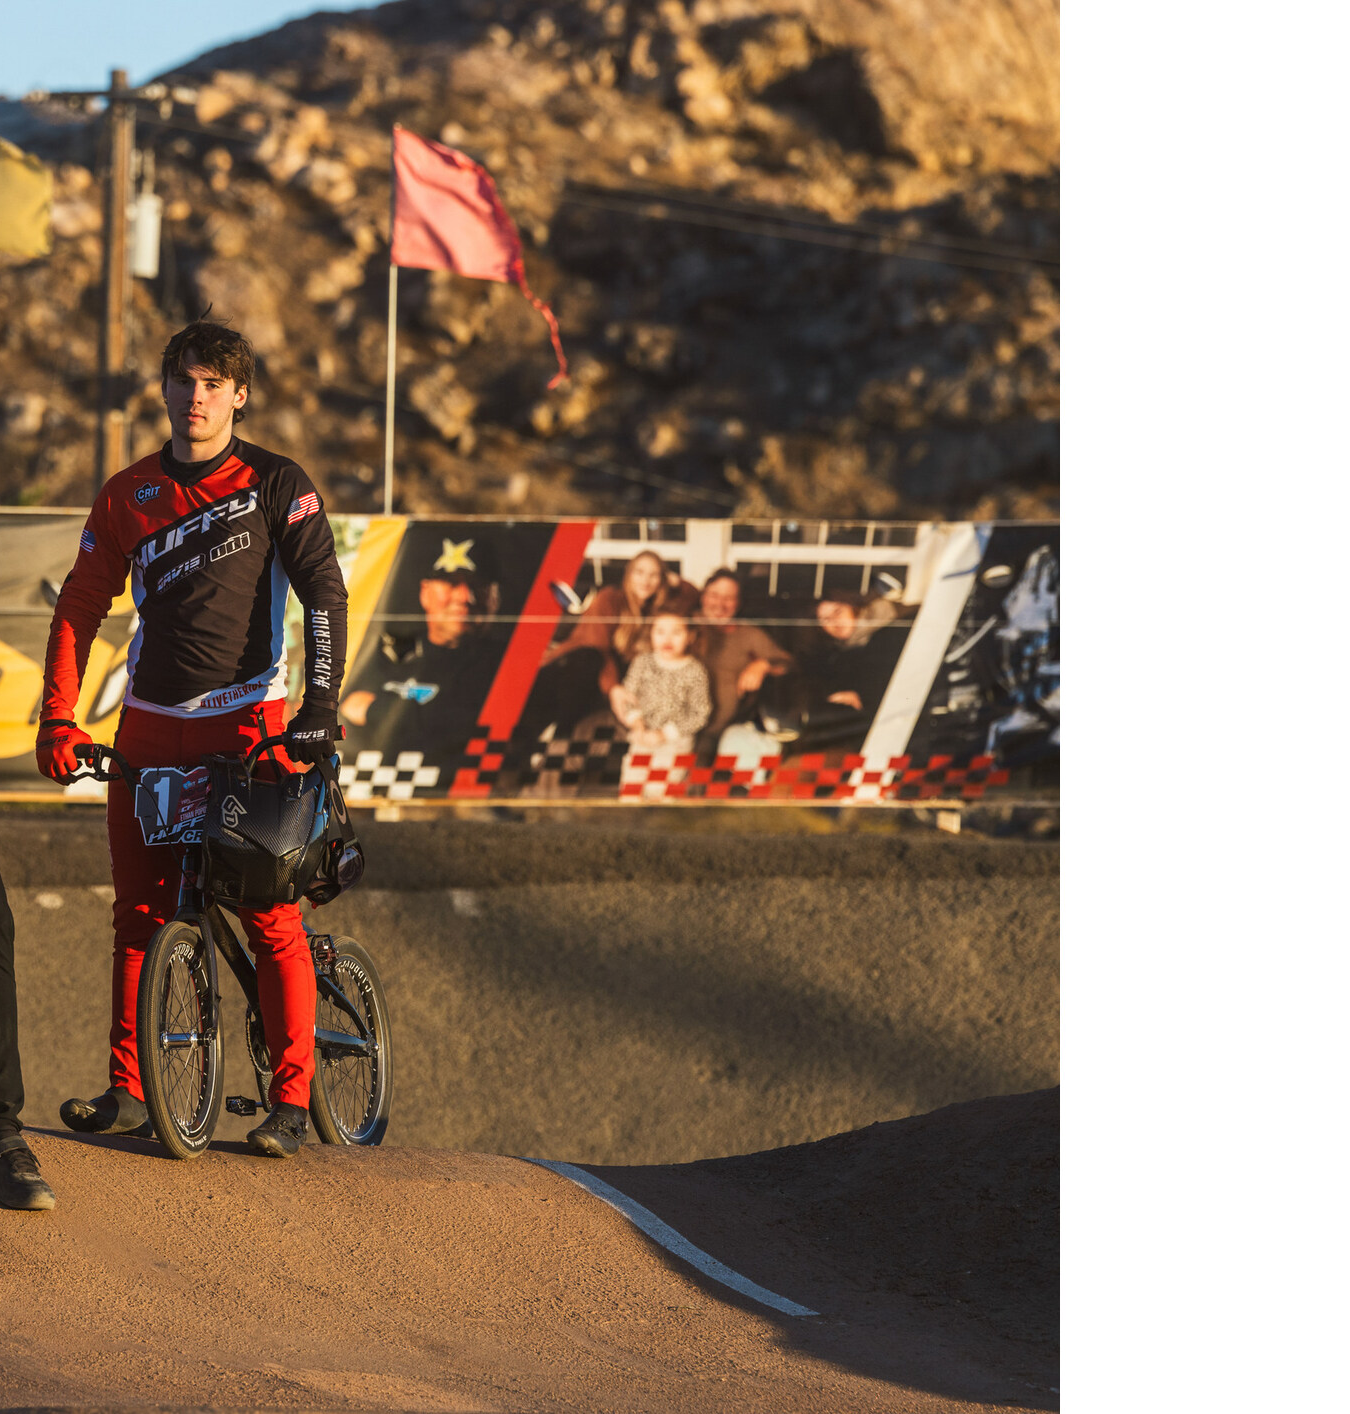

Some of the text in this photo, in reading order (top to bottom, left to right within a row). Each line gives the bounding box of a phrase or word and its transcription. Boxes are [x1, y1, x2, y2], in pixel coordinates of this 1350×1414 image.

[137, 485, 161, 500] CRIT
[154, 777, 171, 827] 1
[148, 814, 206, 844] HUFF
[183, 831, 202, 842] CR
